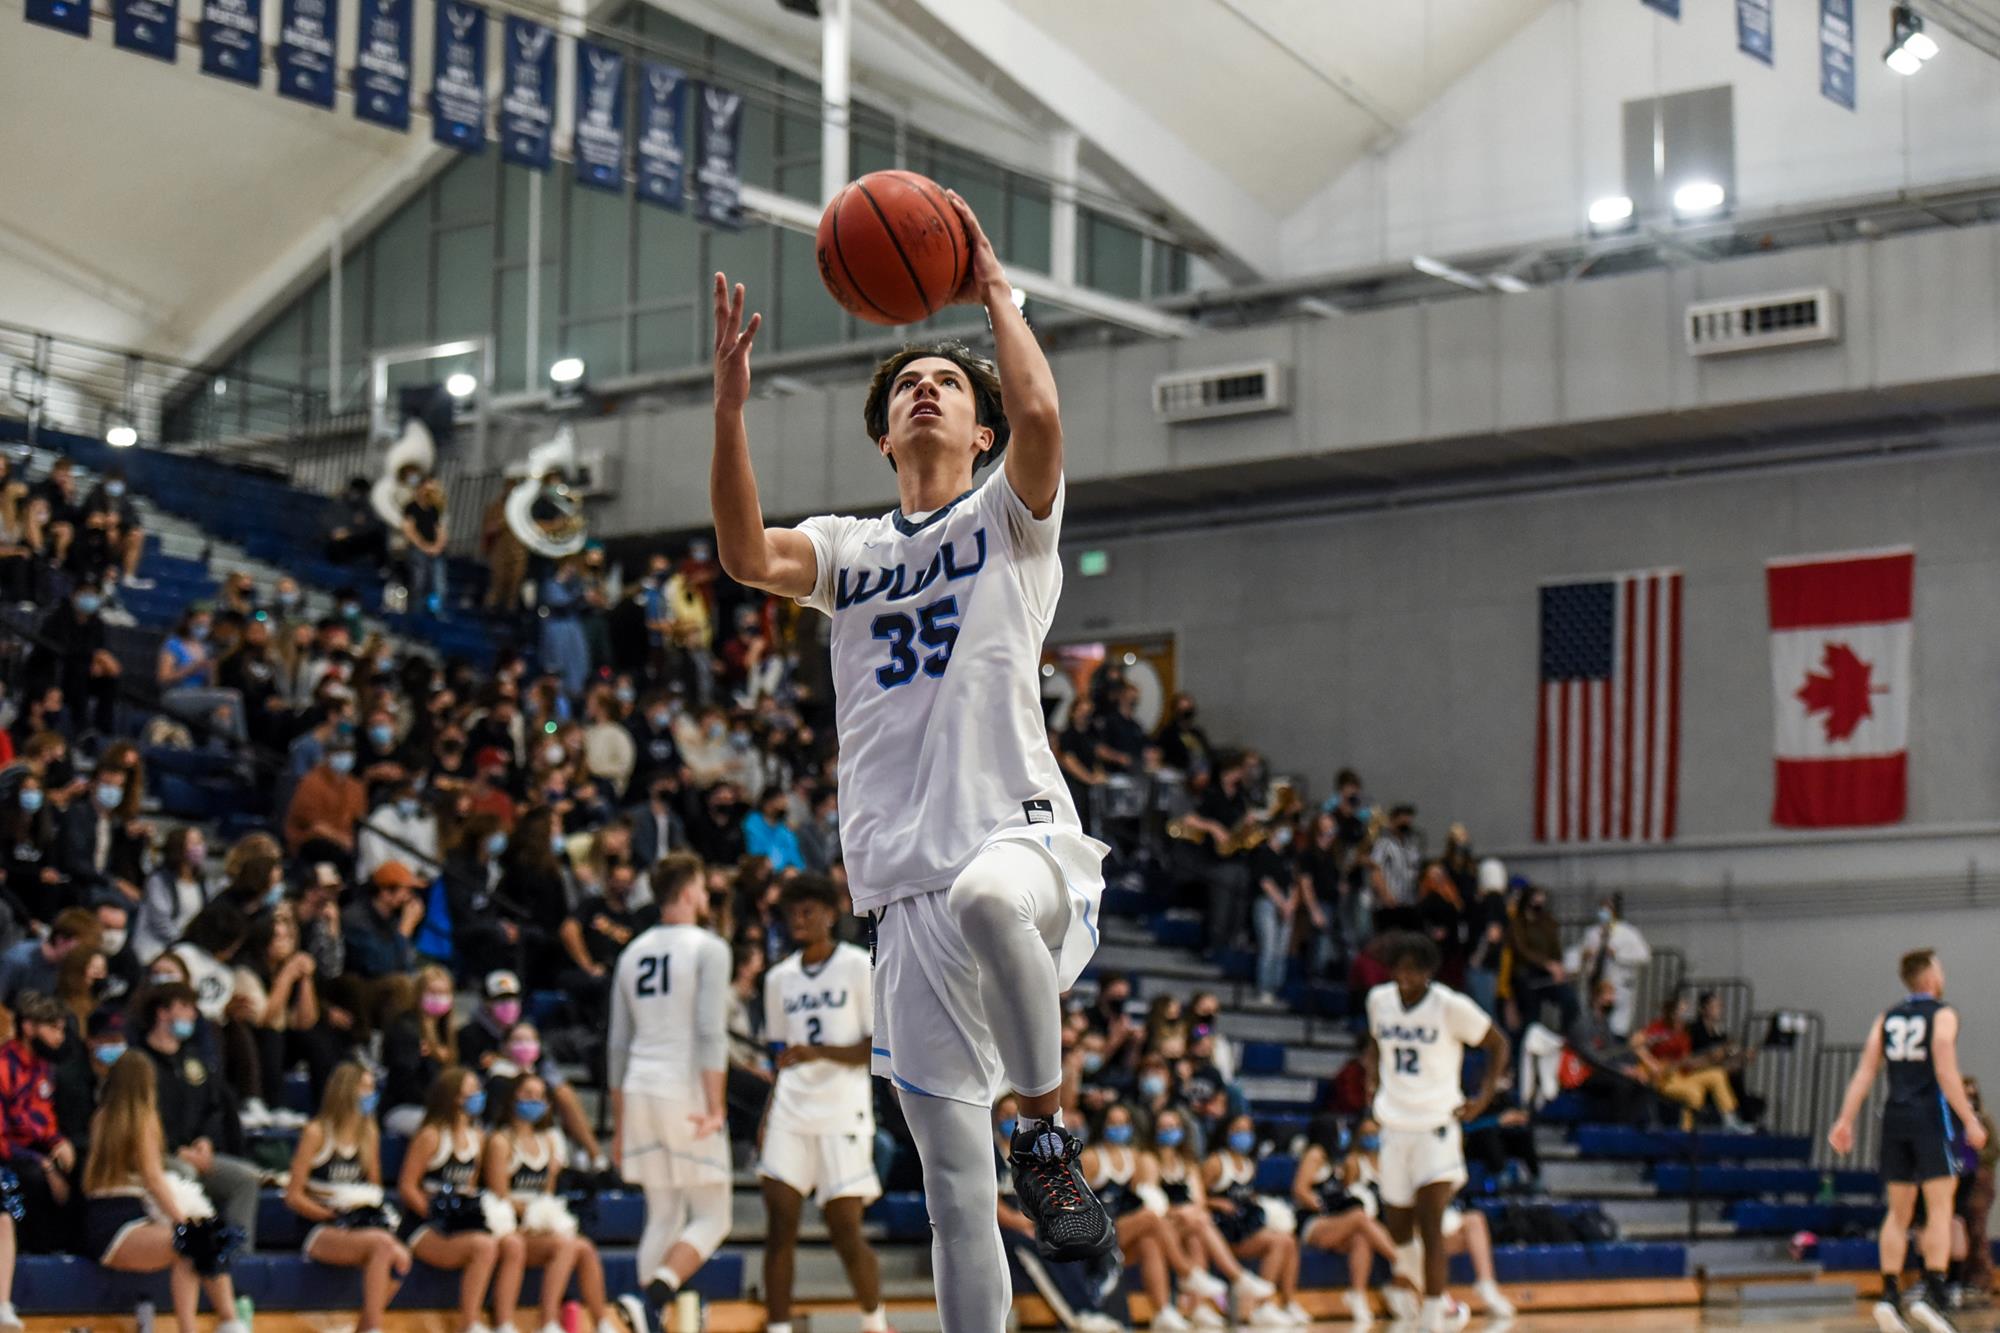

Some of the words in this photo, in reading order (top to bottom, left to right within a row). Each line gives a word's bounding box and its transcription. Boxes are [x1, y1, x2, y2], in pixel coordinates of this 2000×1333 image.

[835, 527, 986, 611] WWU
[870, 594, 960, 690] 35
[1033, 801, 1043, 809] L
[637, 954, 670, 997] 21
[806, 1017, 822, 1045] 2
[1885, 1015, 1927, 1061] 32
[1394, 1047, 1419, 1074] 12
